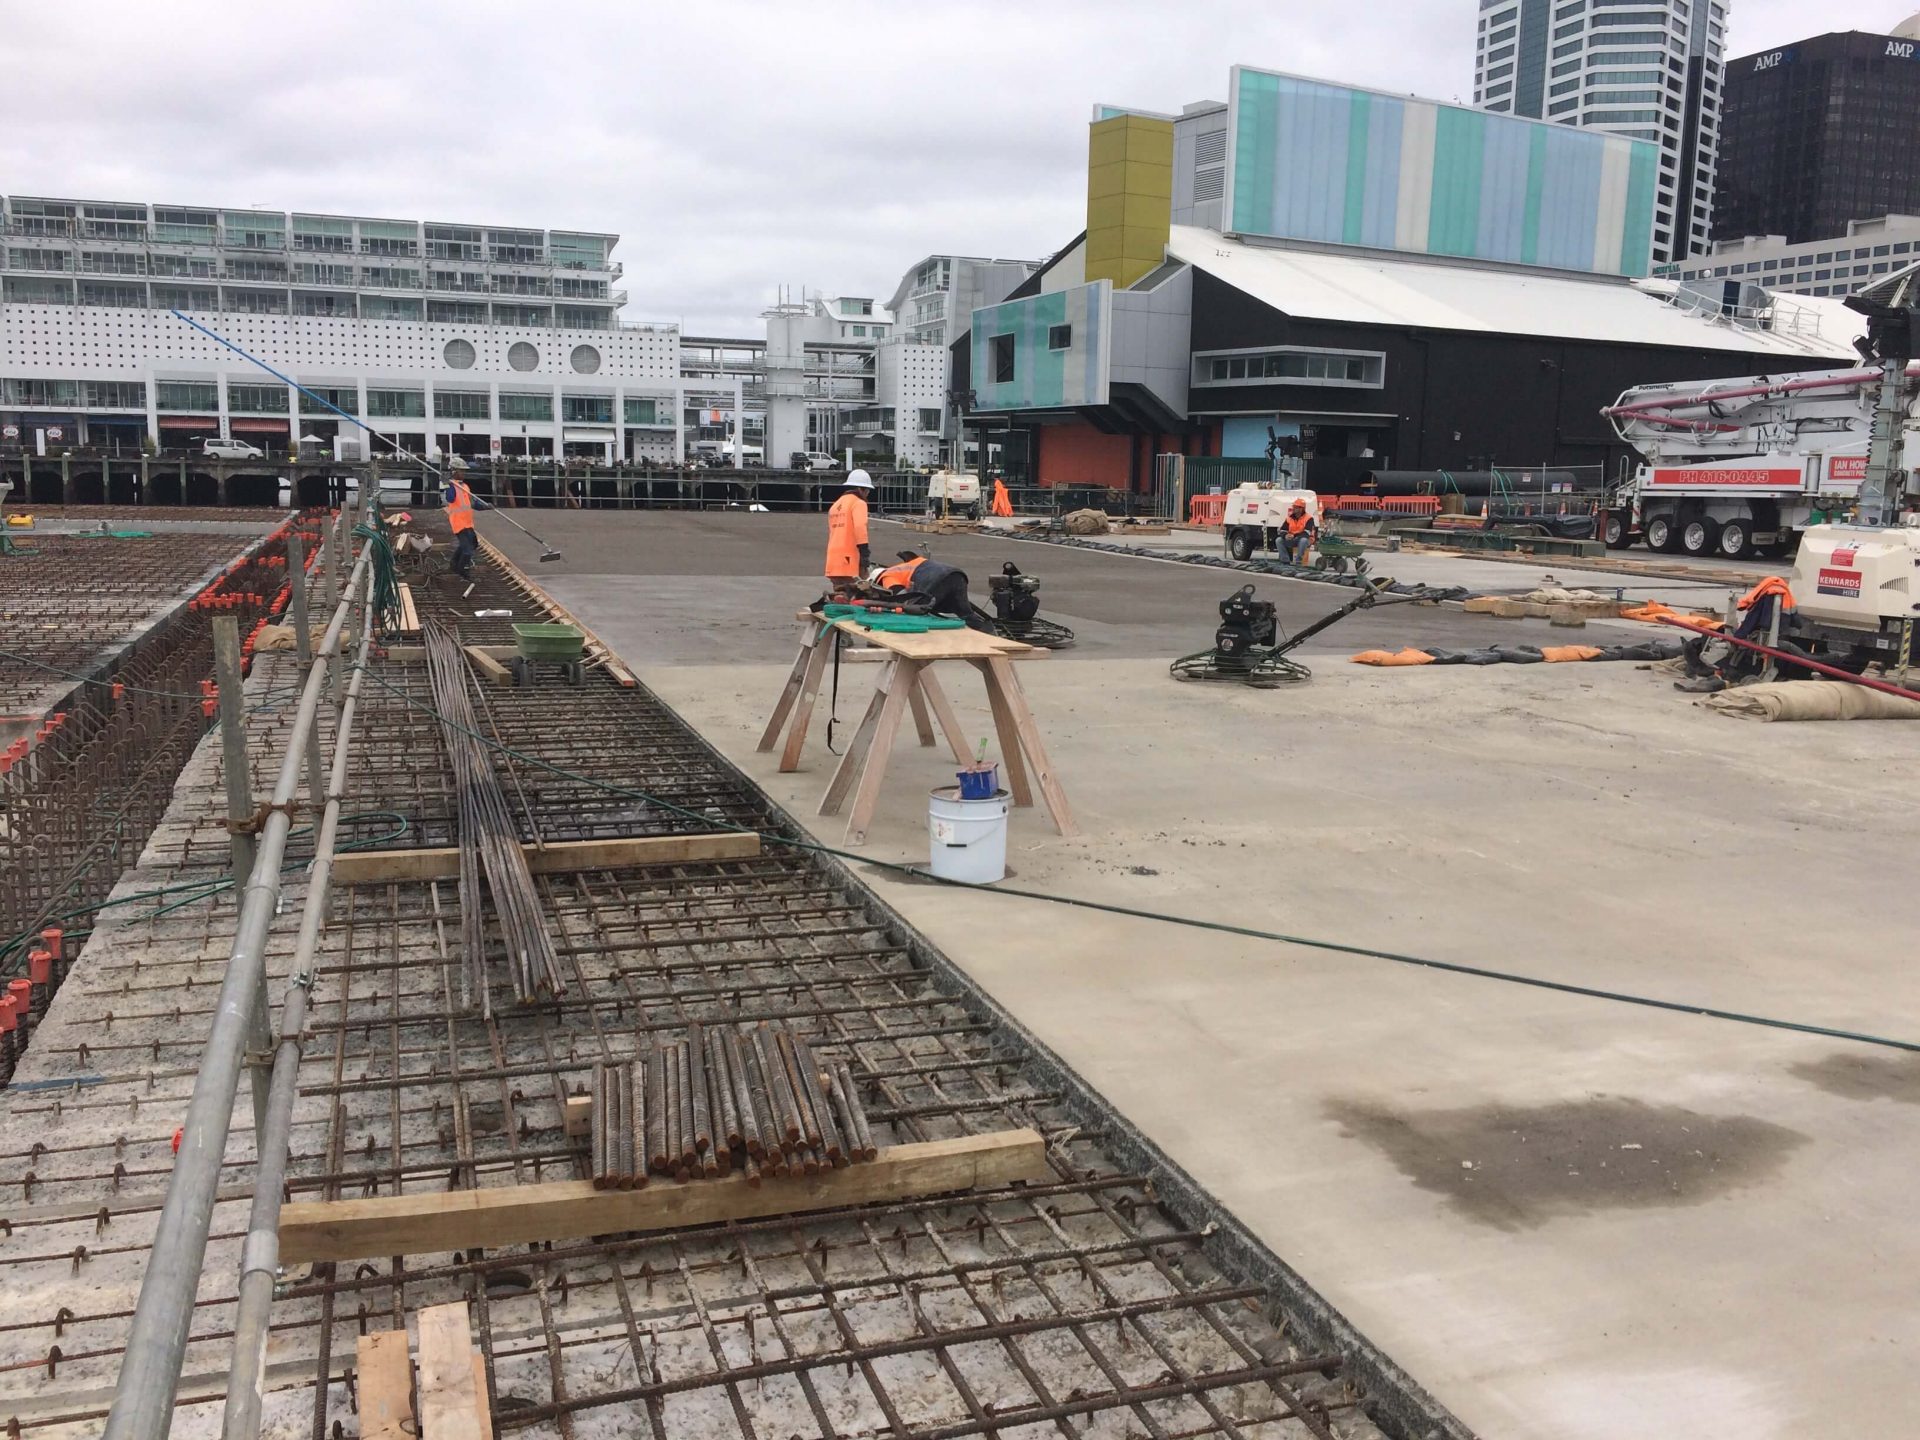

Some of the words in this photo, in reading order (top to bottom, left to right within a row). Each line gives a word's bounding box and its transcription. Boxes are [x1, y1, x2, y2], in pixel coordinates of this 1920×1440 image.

[1885, 41, 1914, 58] AMP
[1753, 52, 1783, 71] AMP
[1834, 461, 1847, 470] IAN
[1679, 470, 1698, 483] PH
[1699, 470, 1770, 483] 416-0445
[1819, 575, 1860, 588] KENNARDS
[1842, 588, 1859, 597] HIRE
